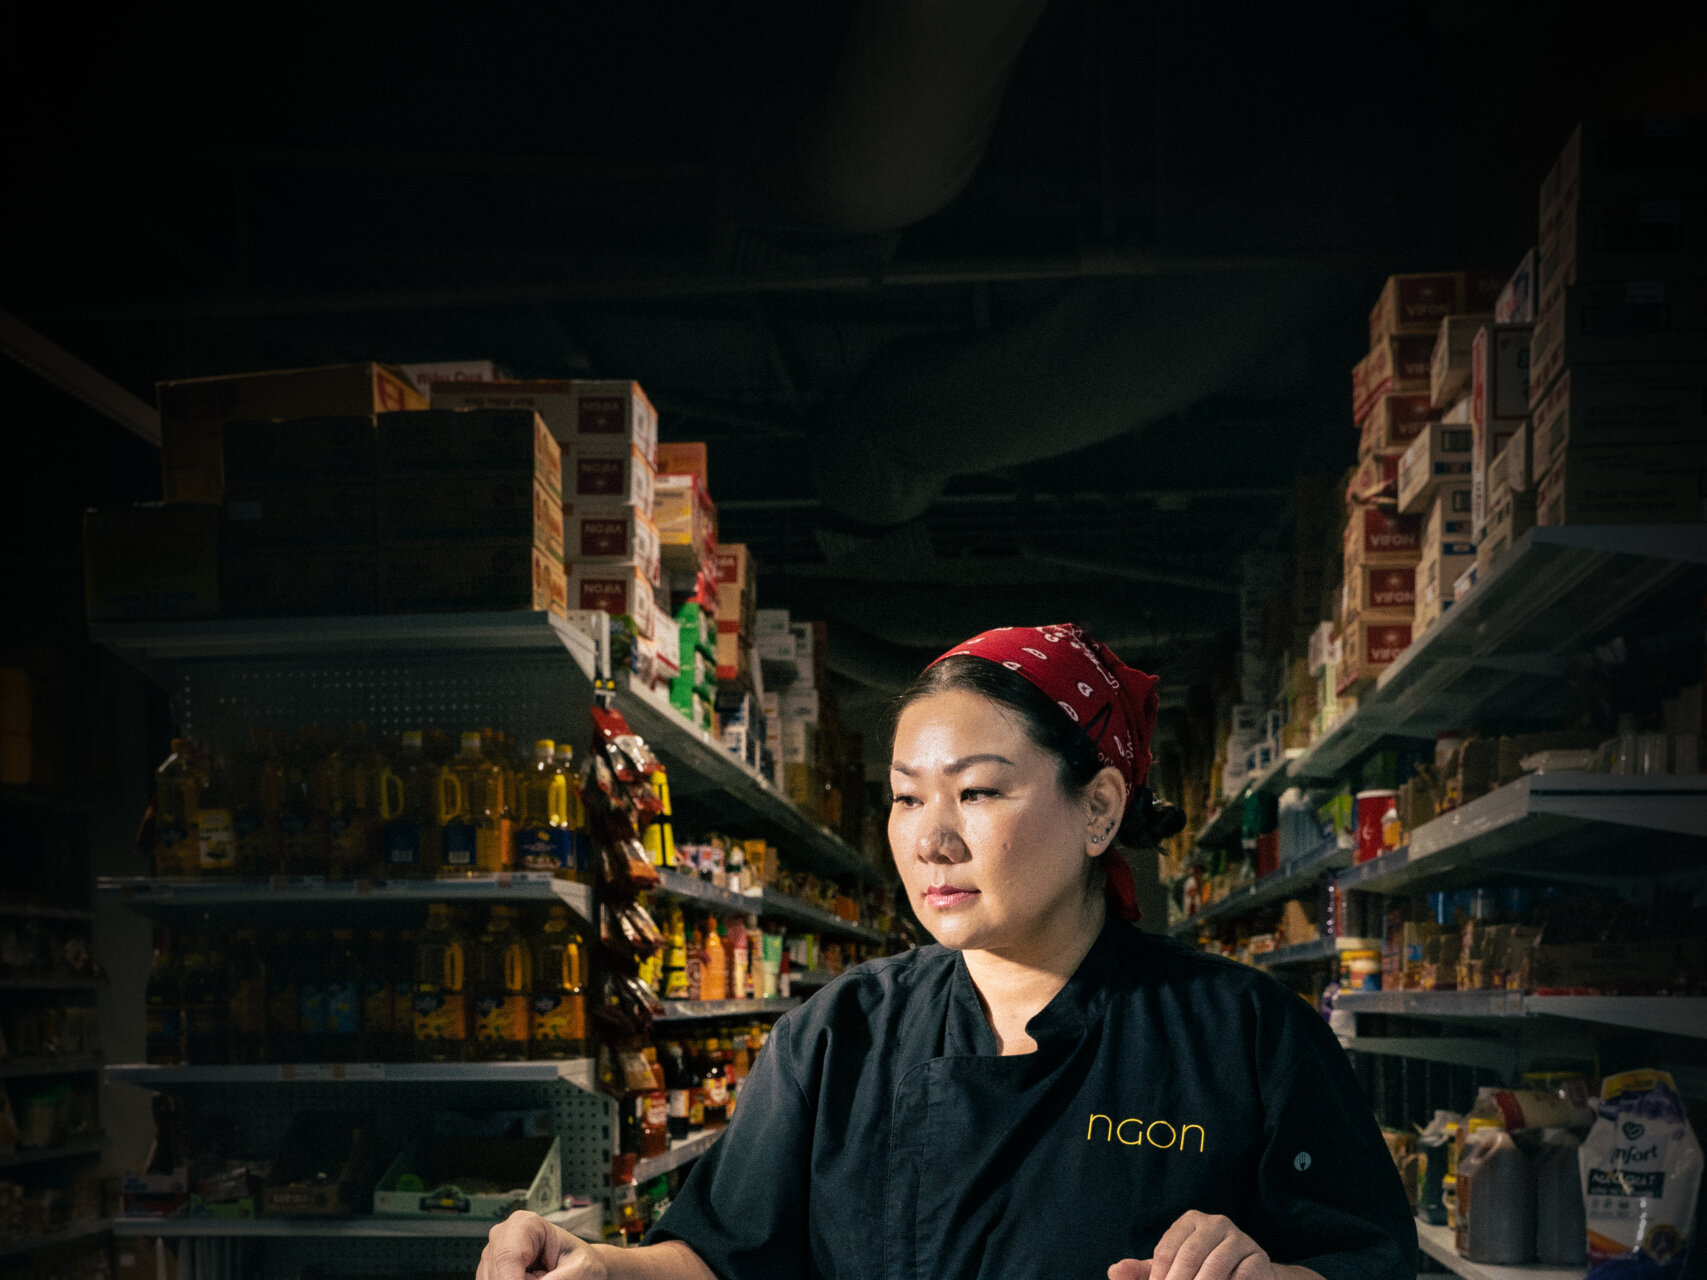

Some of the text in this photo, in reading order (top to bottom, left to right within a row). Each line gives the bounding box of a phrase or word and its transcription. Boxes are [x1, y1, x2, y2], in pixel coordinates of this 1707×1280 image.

[1405, 303, 1450, 316] VIFON
[1369, 533, 1416, 546] VIFON
[1370, 647, 1401, 660] VIFO
